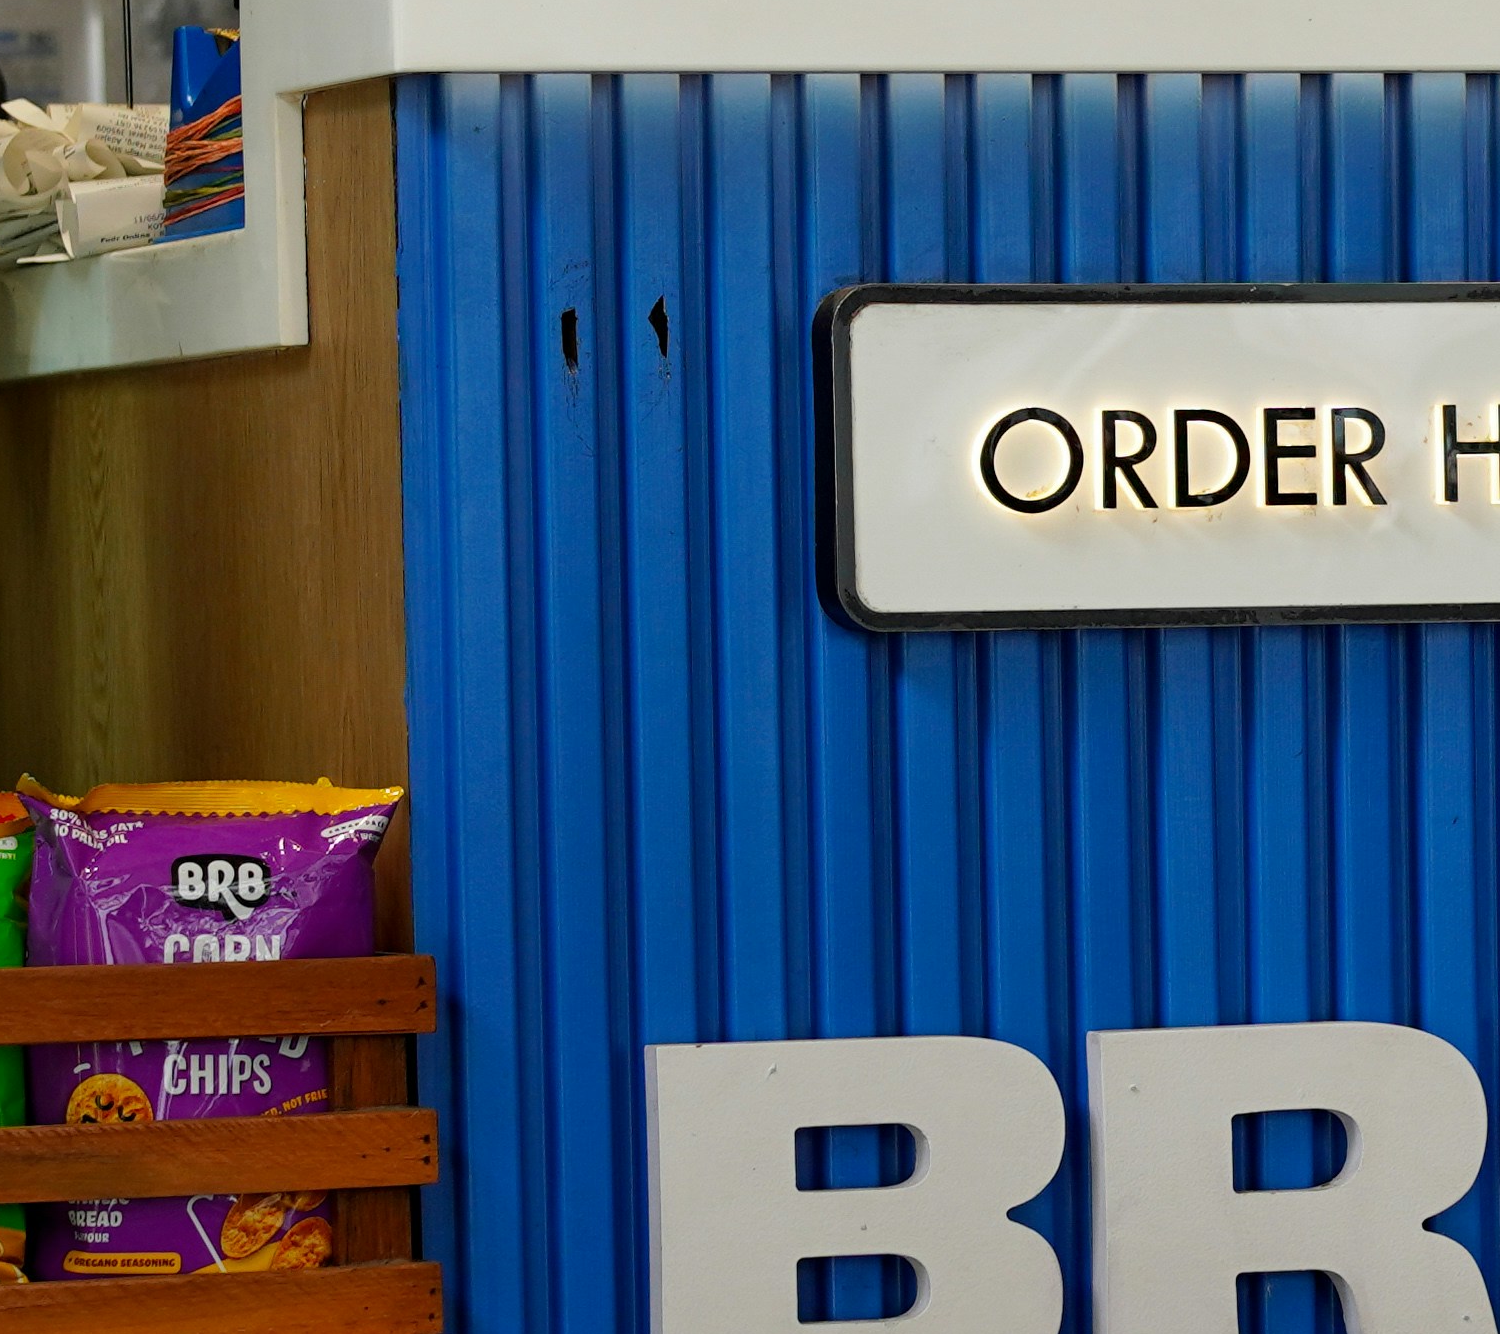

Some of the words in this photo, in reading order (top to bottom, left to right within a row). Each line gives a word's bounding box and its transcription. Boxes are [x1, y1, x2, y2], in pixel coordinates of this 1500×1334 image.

[979, 407, 1387, 514] ORDER
[50, 807, 81, 826] 30%
[177, 859, 267, 921] BRB
[163, 1052, 272, 1097] CHIPS
[282, 1096, 303, 1113] NOT
[305, 1088, 329, 1105] FRIE
[68, 1210, 123, 1228] BREAD
[74, 1257, 118, 1268] OREGANO
[120, 1257, 176, 1268] SEASONING
